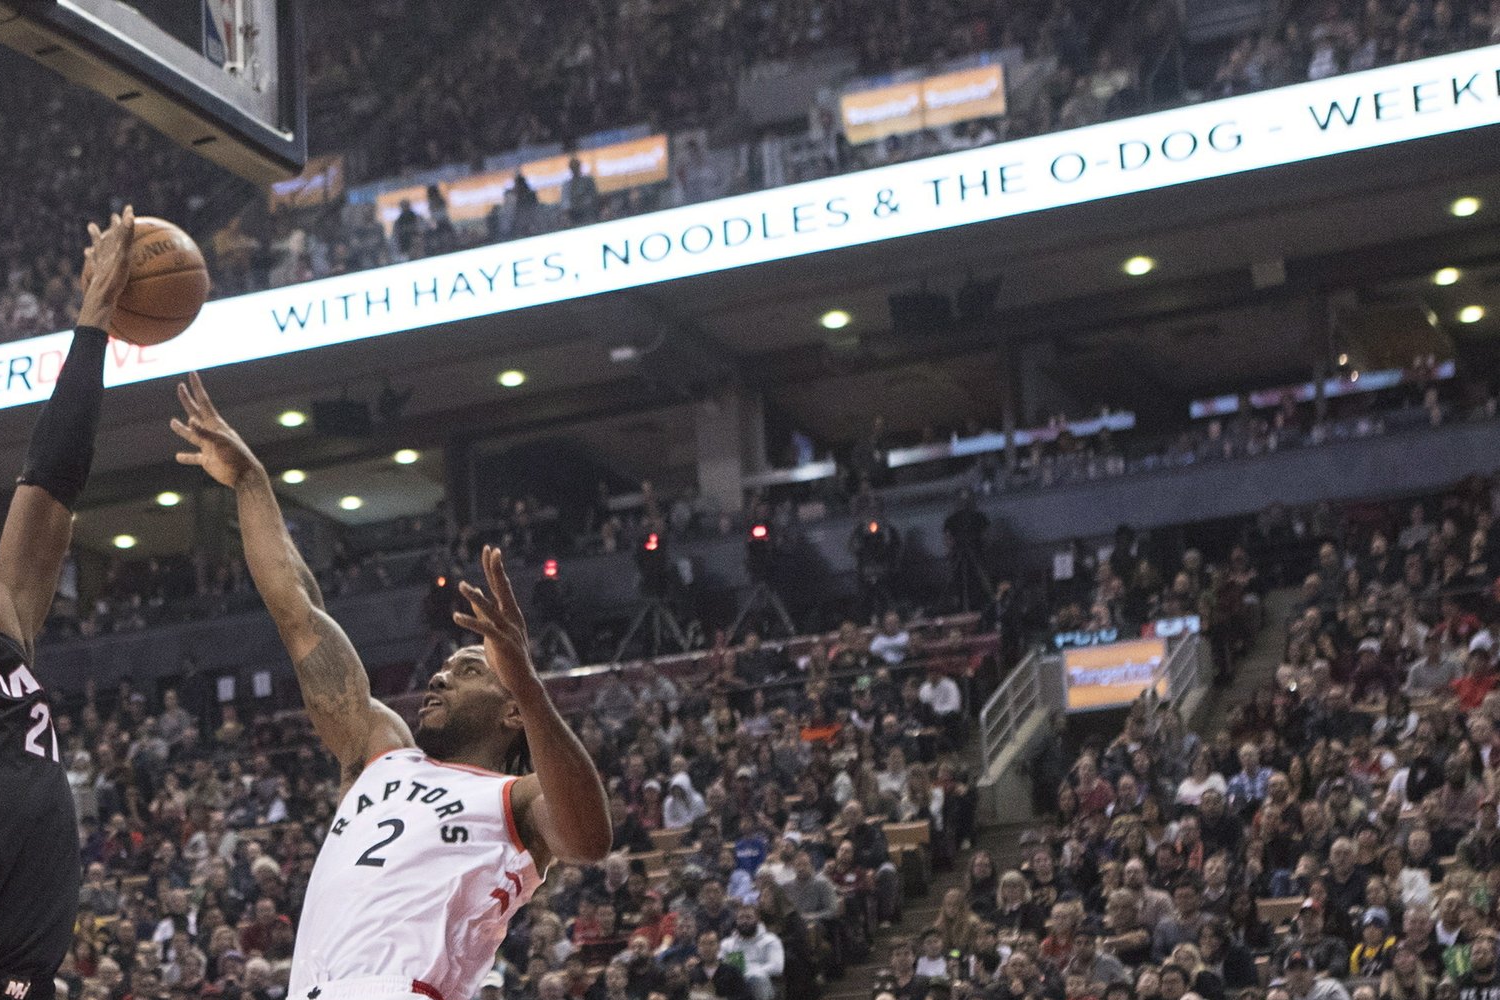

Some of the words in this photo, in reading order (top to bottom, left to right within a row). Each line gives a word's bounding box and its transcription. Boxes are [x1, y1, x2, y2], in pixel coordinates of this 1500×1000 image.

[271, 286, 391, 333] WITH
[413, 252, 580, 308] HAYES,
[601, 196, 850, 270] NOODLES
[873, 189, 900, 218] &
[924, 162, 1027, 206] THE
[1050, 121, 1243, 183] O-DOG
[1309, 68, 1500, 131] WEEK
[331, 779, 469, 844] RAPTORS
[355, 818, 405, 868] 2
